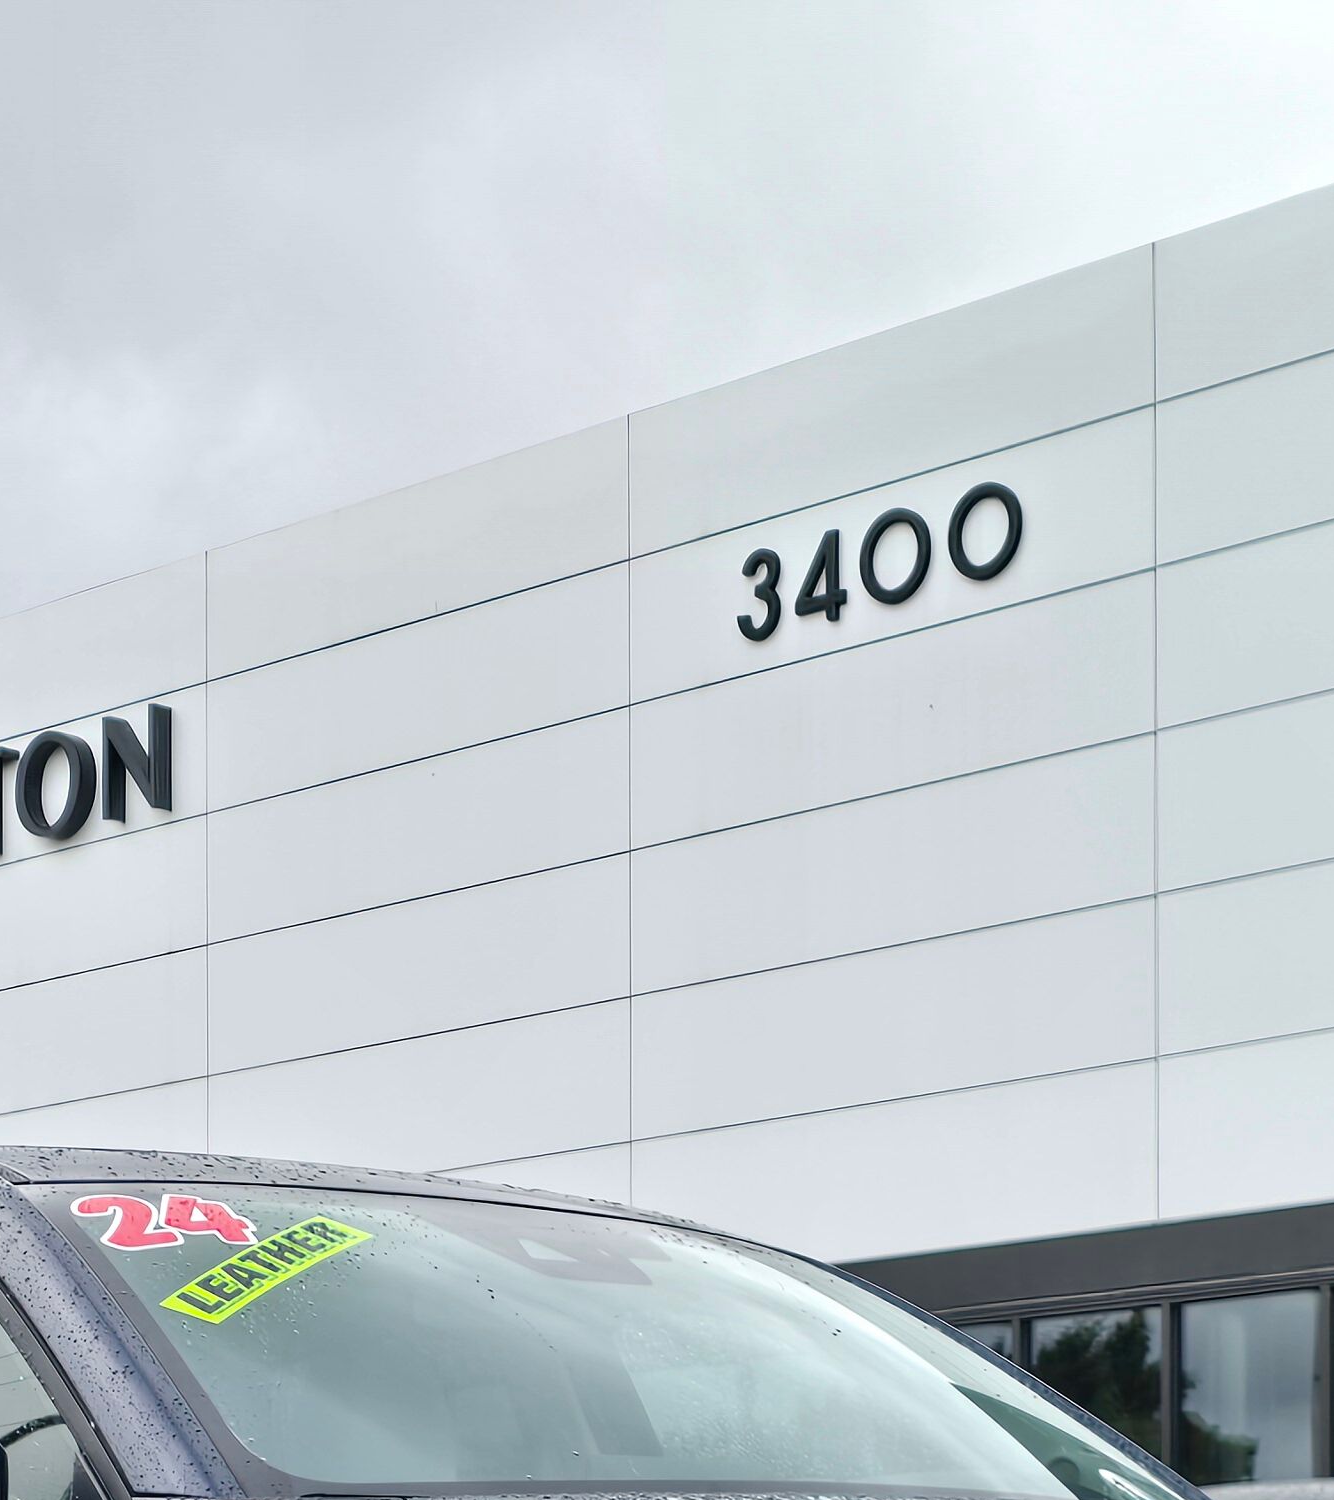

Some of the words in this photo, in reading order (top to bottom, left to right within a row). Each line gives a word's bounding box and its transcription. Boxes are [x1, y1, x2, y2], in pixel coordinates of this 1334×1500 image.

[736, 481, 1023, 642] 3400
[70, 1194, 259, 1250] 24
[176, 1219, 352, 1314] LEATHER
